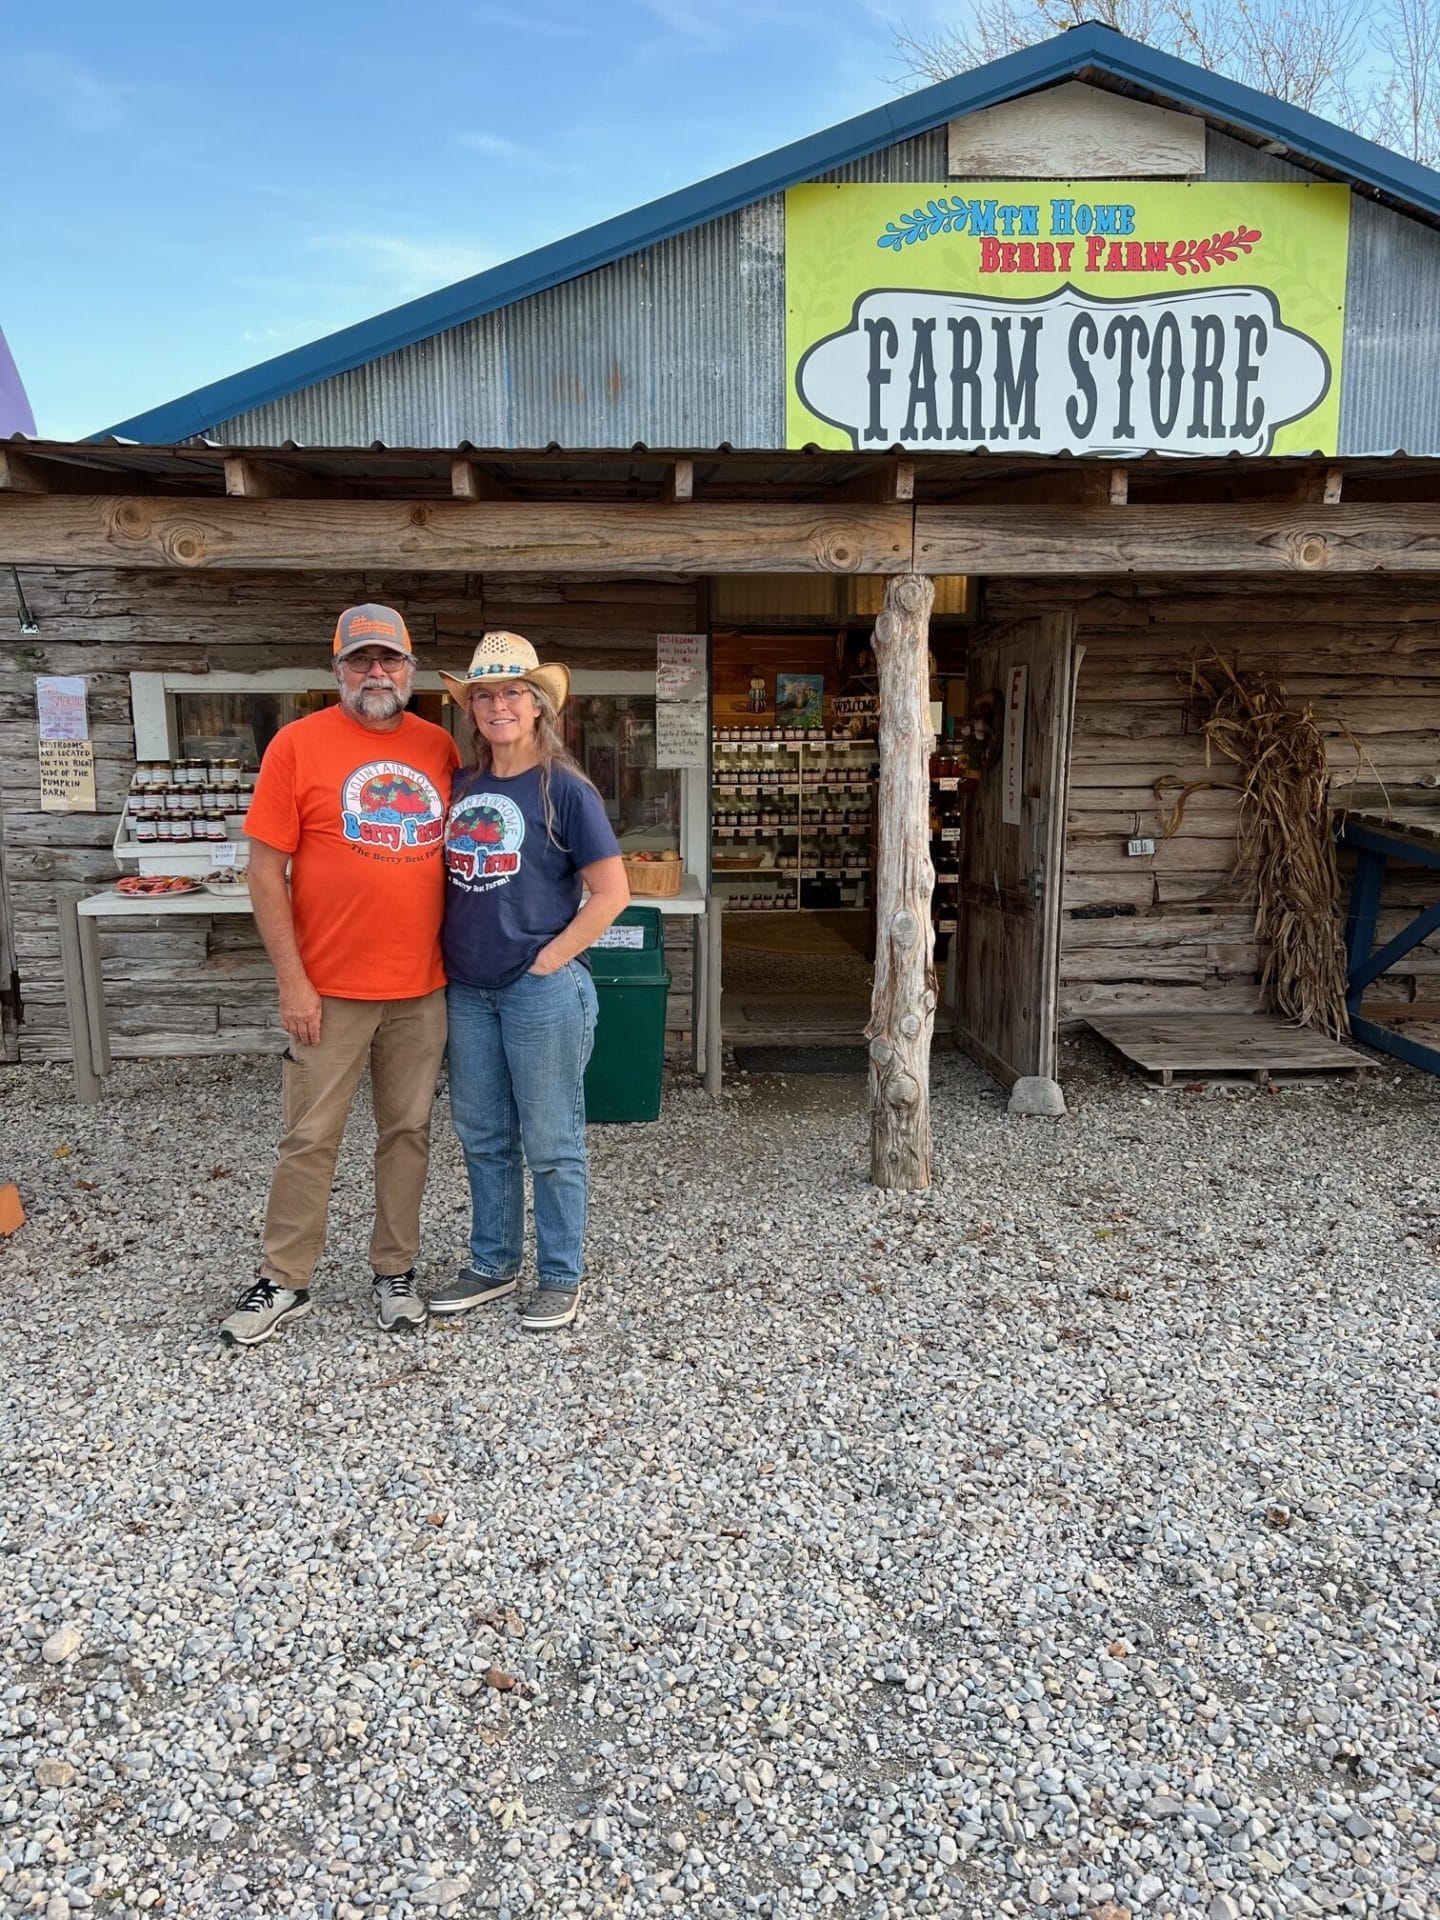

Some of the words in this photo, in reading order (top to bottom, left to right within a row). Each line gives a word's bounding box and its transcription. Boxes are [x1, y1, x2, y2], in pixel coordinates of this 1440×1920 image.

[968, 199, 1040, 236] MTN
[1050, 199, 1136, 236] HOME
[979, 237, 1075, 273] BERRY
[1085, 236, 1169, 272] FARM
[863, 315, 1044, 442] FARM
[1065, 310, 1269, 440] STORE
[833, 699, 877, 714] WELCOME
[40, 740, 84, 750] RESTROOMS
[1008, 670, 1022, 811] ENTER
[41, 750, 54, 758] ARE
[73, 759, 93, 768] RIGHT
[41, 769, 58, 777] SIDE
[61, 769, 69, 777] OF
[42, 778, 81, 788] PUMPKIN
[347, 763, 404, 801] MOUNTAIN
[407, 771, 439, 803] HOME
[42, 788, 69, 798] BARN.
[342, 812, 401, 851] Berry
[402, 817, 442, 846] Farm
[351, 843, 370, 858] The
[373, 851, 402, 865] Berry
[405, 854, 425, 863] Best
